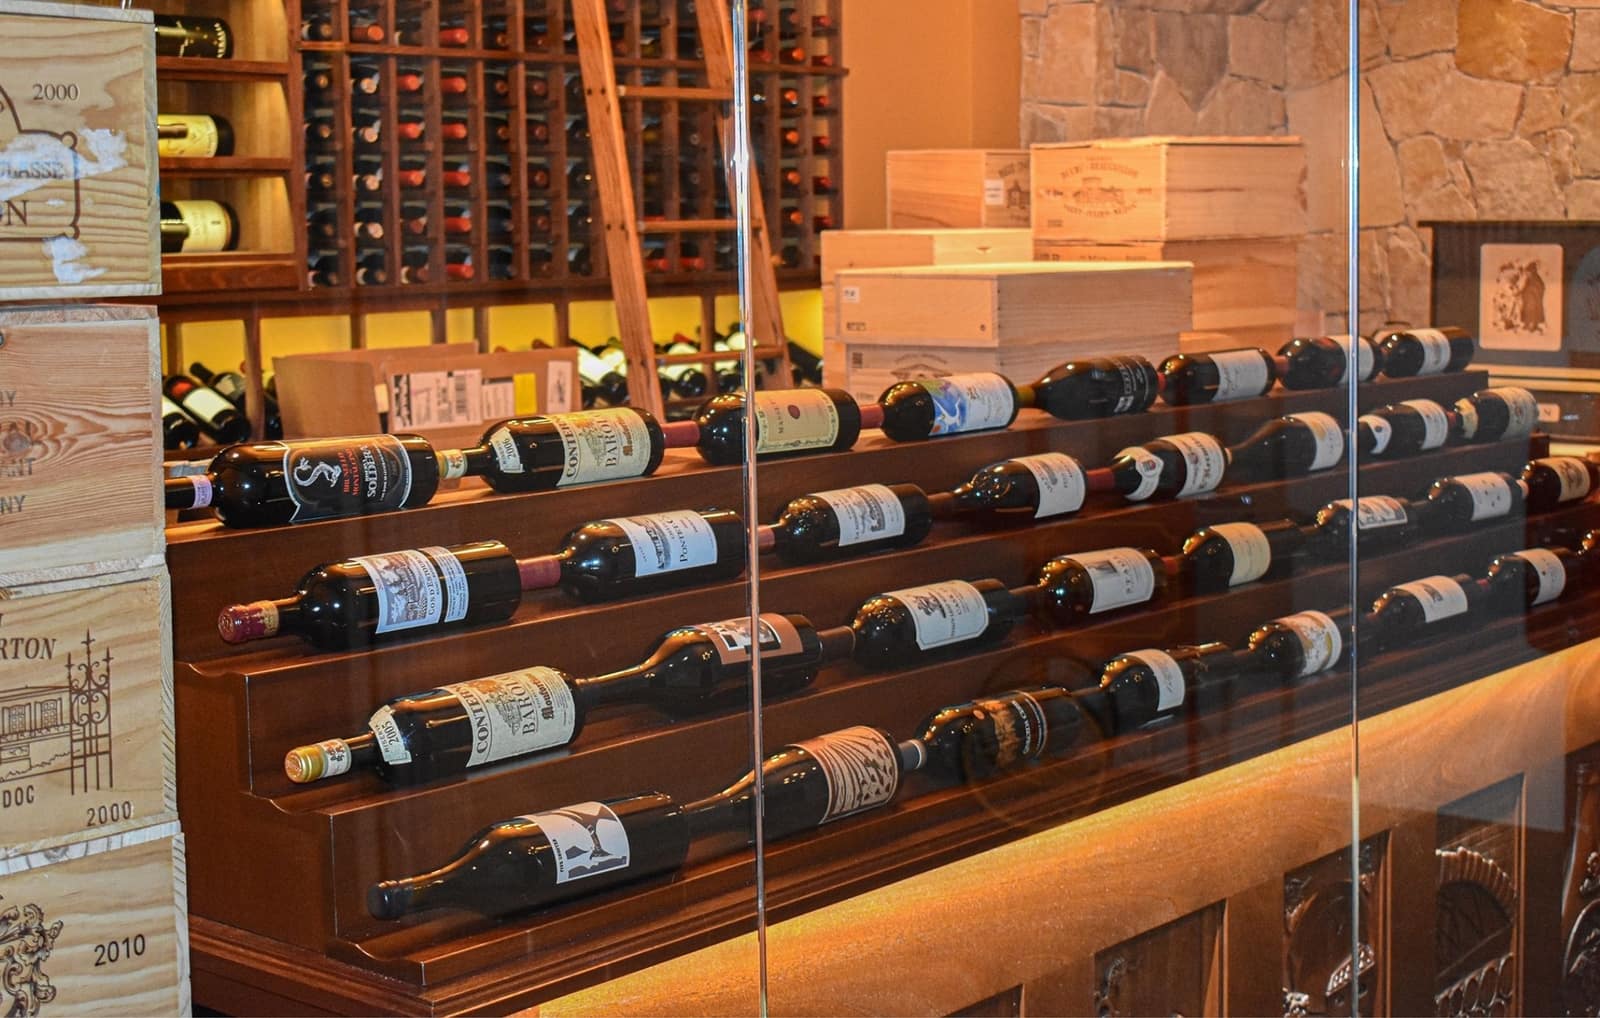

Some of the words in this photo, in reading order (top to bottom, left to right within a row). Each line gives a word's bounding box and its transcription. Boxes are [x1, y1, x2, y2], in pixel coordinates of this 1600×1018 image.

[32, 83, 79, 101] 2000
[360, 444, 378, 498] SOLDERA
[381, 720, 400, 746] 2005
[86, 800, 133, 828] 2000
[93, 933, 147, 967] 2010
